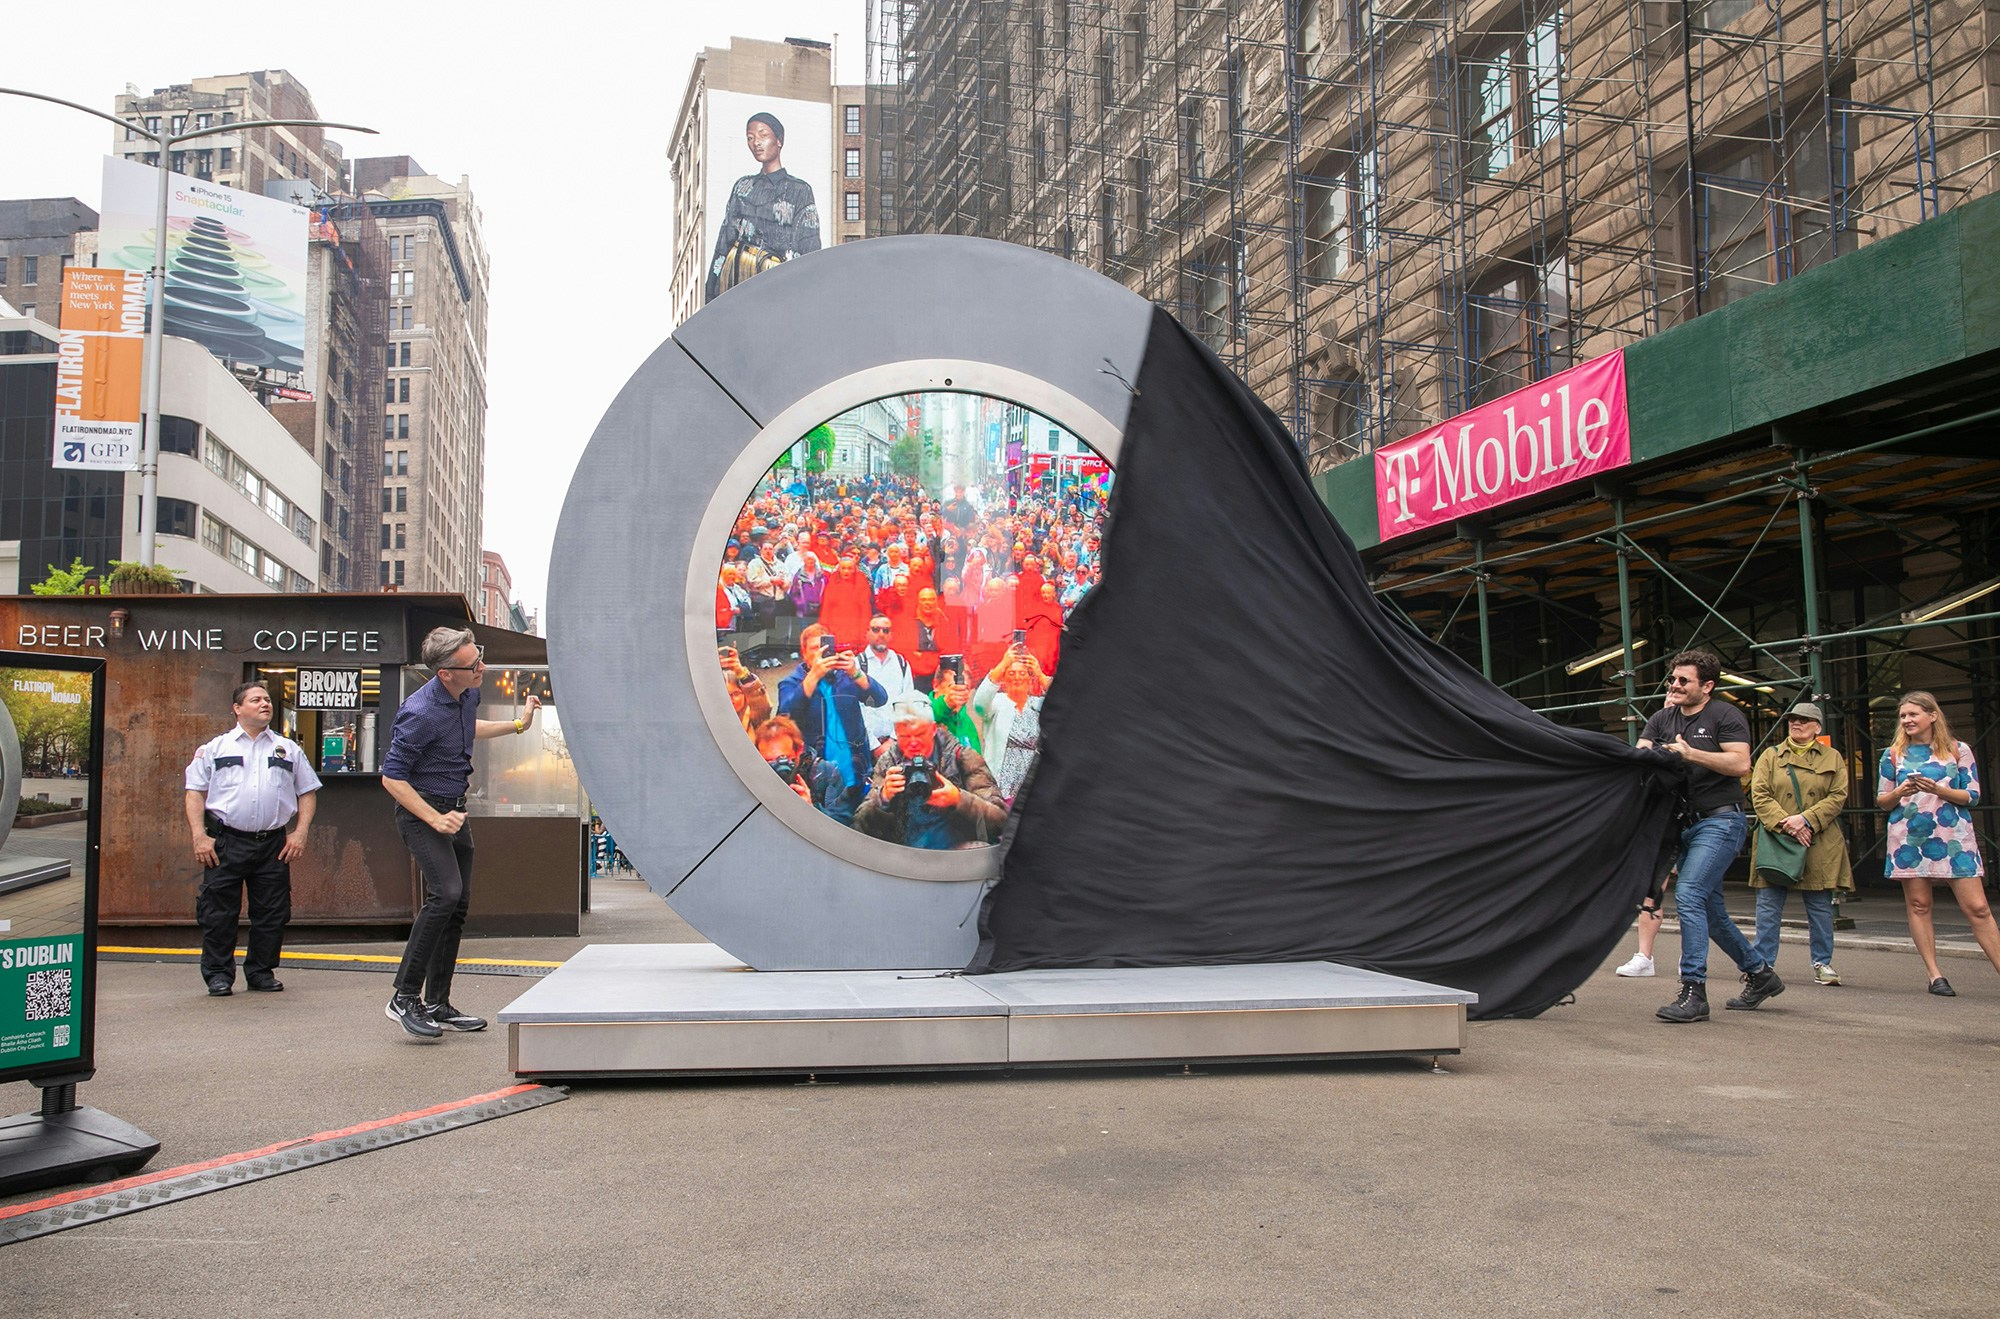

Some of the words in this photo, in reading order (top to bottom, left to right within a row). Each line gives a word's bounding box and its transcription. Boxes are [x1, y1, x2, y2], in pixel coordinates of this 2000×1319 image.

[197, 188, 223, 199] iPhone
[223, 194, 232, 202] 15
[175, 190, 245, 217] Snaptacular.
[71, 271, 104, 281] Where
[70, 281, 92, 291] New
[94, 282, 116, 292] York
[69, 291, 99, 300] meets
[69, 299, 91, 309] New
[93, 301, 115, 311] York
[121, 269, 146, 338] NOMAD
[56, 329, 85, 417] FLATIRON
[61, 425, 133, 436] FLATIRONNOMAD.NYC
[90, 442, 129, 458] GFP
[18, 625, 105, 648] BEER
[137, 628, 223, 651] WINE
[253, 629, 379, 652] COFFEE
[14, 680, 54, 693] FLATIRON
[299, 670, 359, 692] BRONX
[50, 691, 81, 704] NOMAD
[299, 691, 358, 707] BREWERY
[0, 948, 14, 969] S
[15, 943, 73, 968] DUBLIN
[25, 1030, 46, 1038] Cathrach
[27, 1042, 45, 1050] Council
